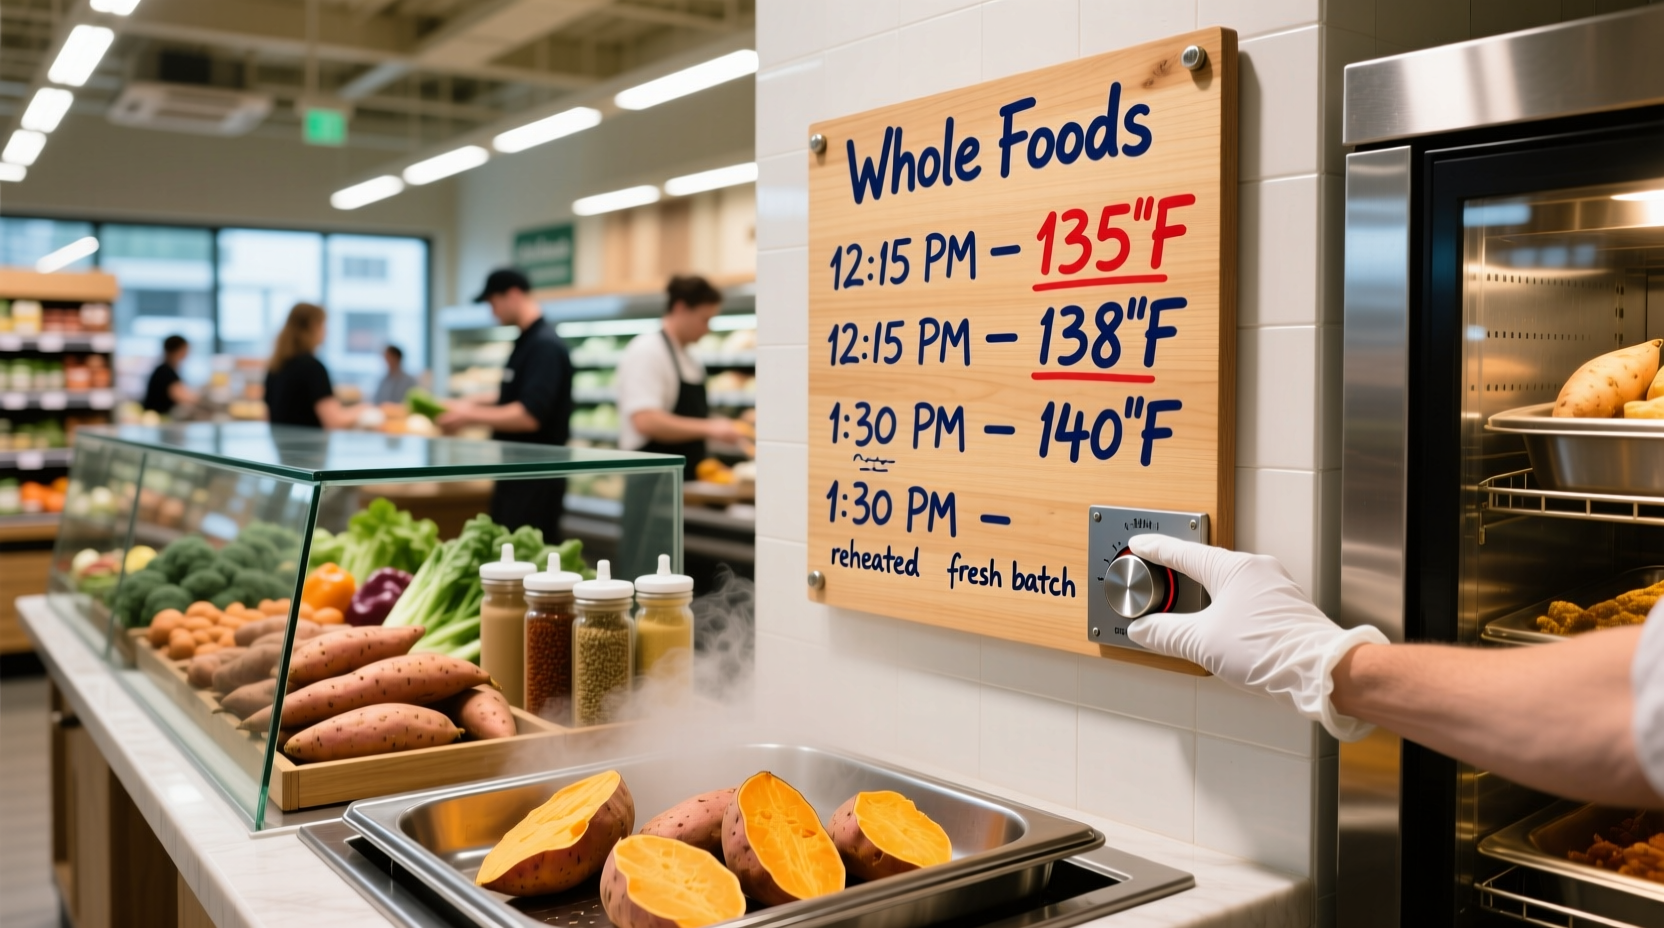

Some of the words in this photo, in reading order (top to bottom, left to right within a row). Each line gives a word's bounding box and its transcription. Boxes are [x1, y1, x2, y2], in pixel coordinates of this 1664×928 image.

[846, 116, 982, 205] Whole
[998, 81, 1153, 179] Foods
[829, 237, 912, 291] 12:15
[924, 230, 977, 283] PM
[827, 320, 906, 367] 12:15
[917, 316, 971, 367] PM
[829, 401, 898, 449] 1:30
[912, 401, 965, 453] PM
[826, 479, 894, 527] 1:30
[906, 485, 957, 538] PM
[831, 538, 920, 578] reheated
[947, 552, 1003, 590] fresh
[1011, 560, 1077, 598] batch
